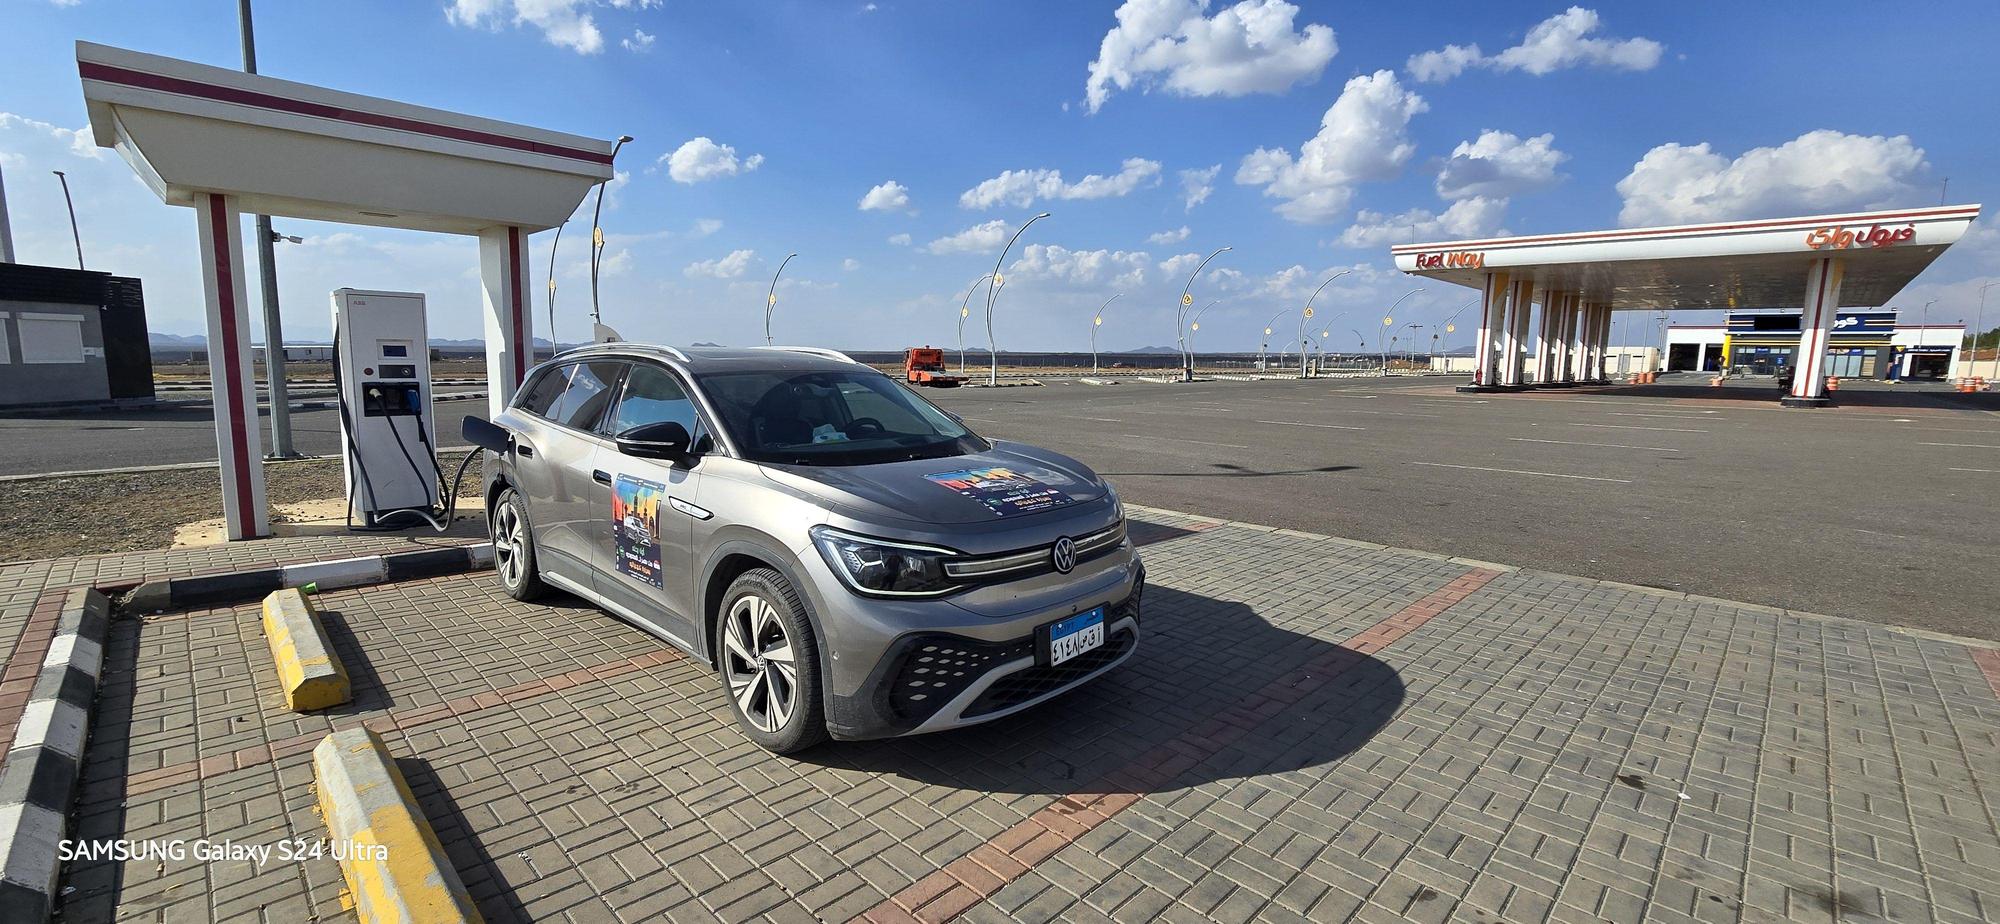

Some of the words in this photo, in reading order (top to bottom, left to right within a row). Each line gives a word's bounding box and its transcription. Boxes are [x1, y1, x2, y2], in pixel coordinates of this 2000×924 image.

[1806, 225, 1854, 249] واي
[1855, 222, 1916, 248] فيول
[1416, 252, 1444, 268] Fuel
[1447, 252, 1485, 269] Way
[1055, 538, 1075, 570] VW
[1053, 636, 1078, 662] ٤١٤٨
